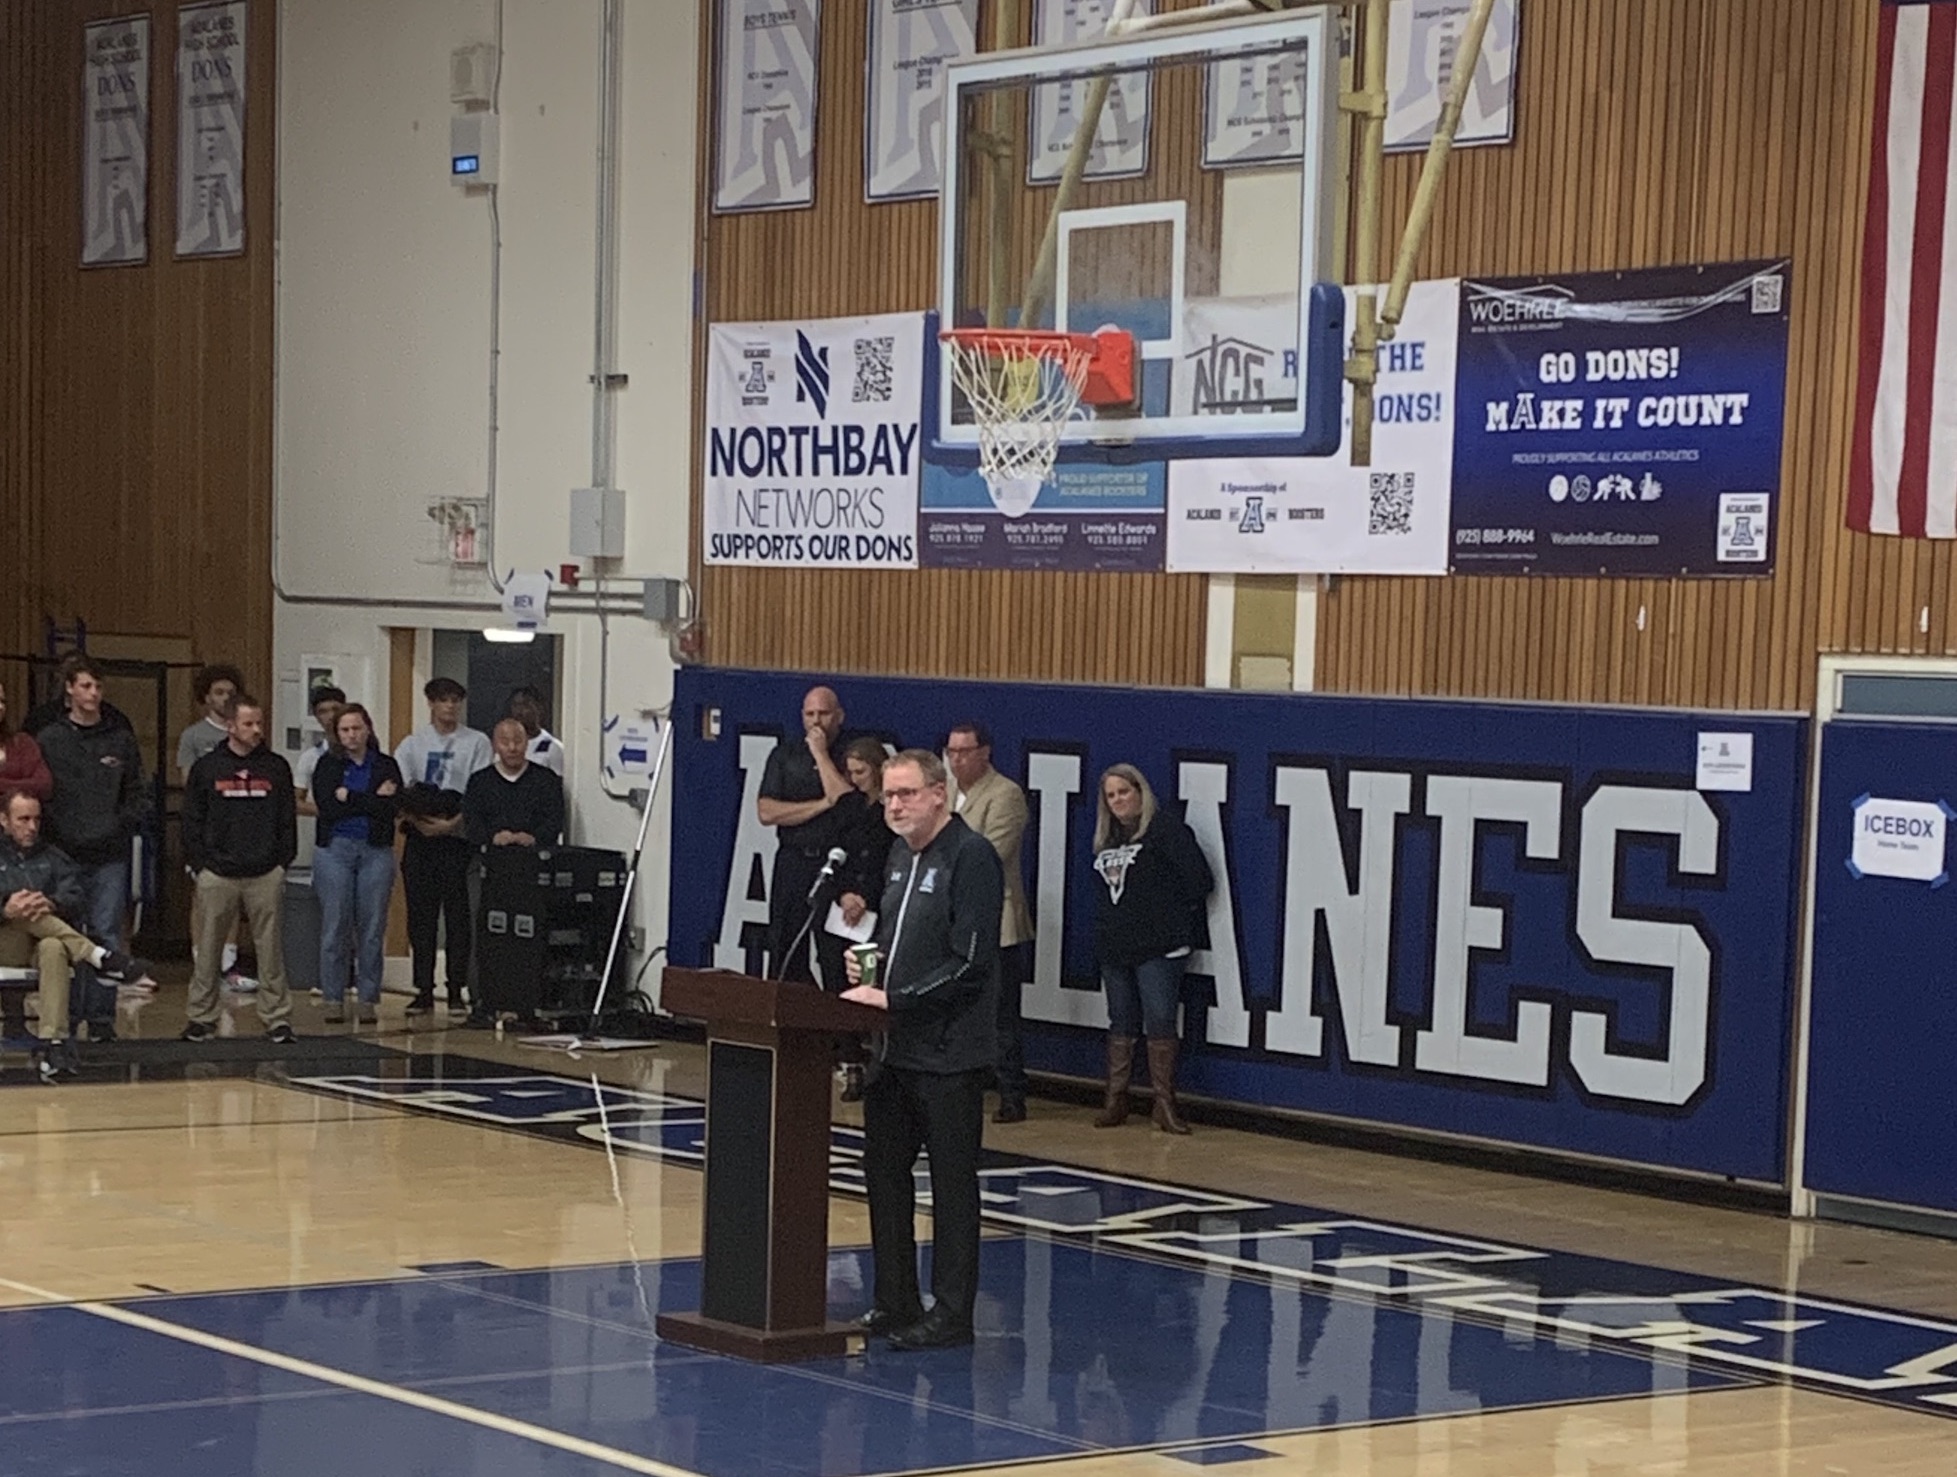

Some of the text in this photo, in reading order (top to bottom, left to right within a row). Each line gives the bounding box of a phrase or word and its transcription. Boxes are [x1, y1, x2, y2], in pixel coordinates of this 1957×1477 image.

[1539, 347, 1679, 383] GO DONS!
[1378, 392, 1441, 423] ONS!
[1485, 393, 1750, 432] MAKE IT COUNT
[710, 423, 918, 478] NORTHBAY
[736, 487, 885, 529] NETWORKS
[1238, 497, 1264, 533] A
[711, 533, 914, 561] SUPPORTS OUR DONS
[1864, 815, 1934, 838] ICEBOX
[712, 734, 1720, 1105] ALANES
